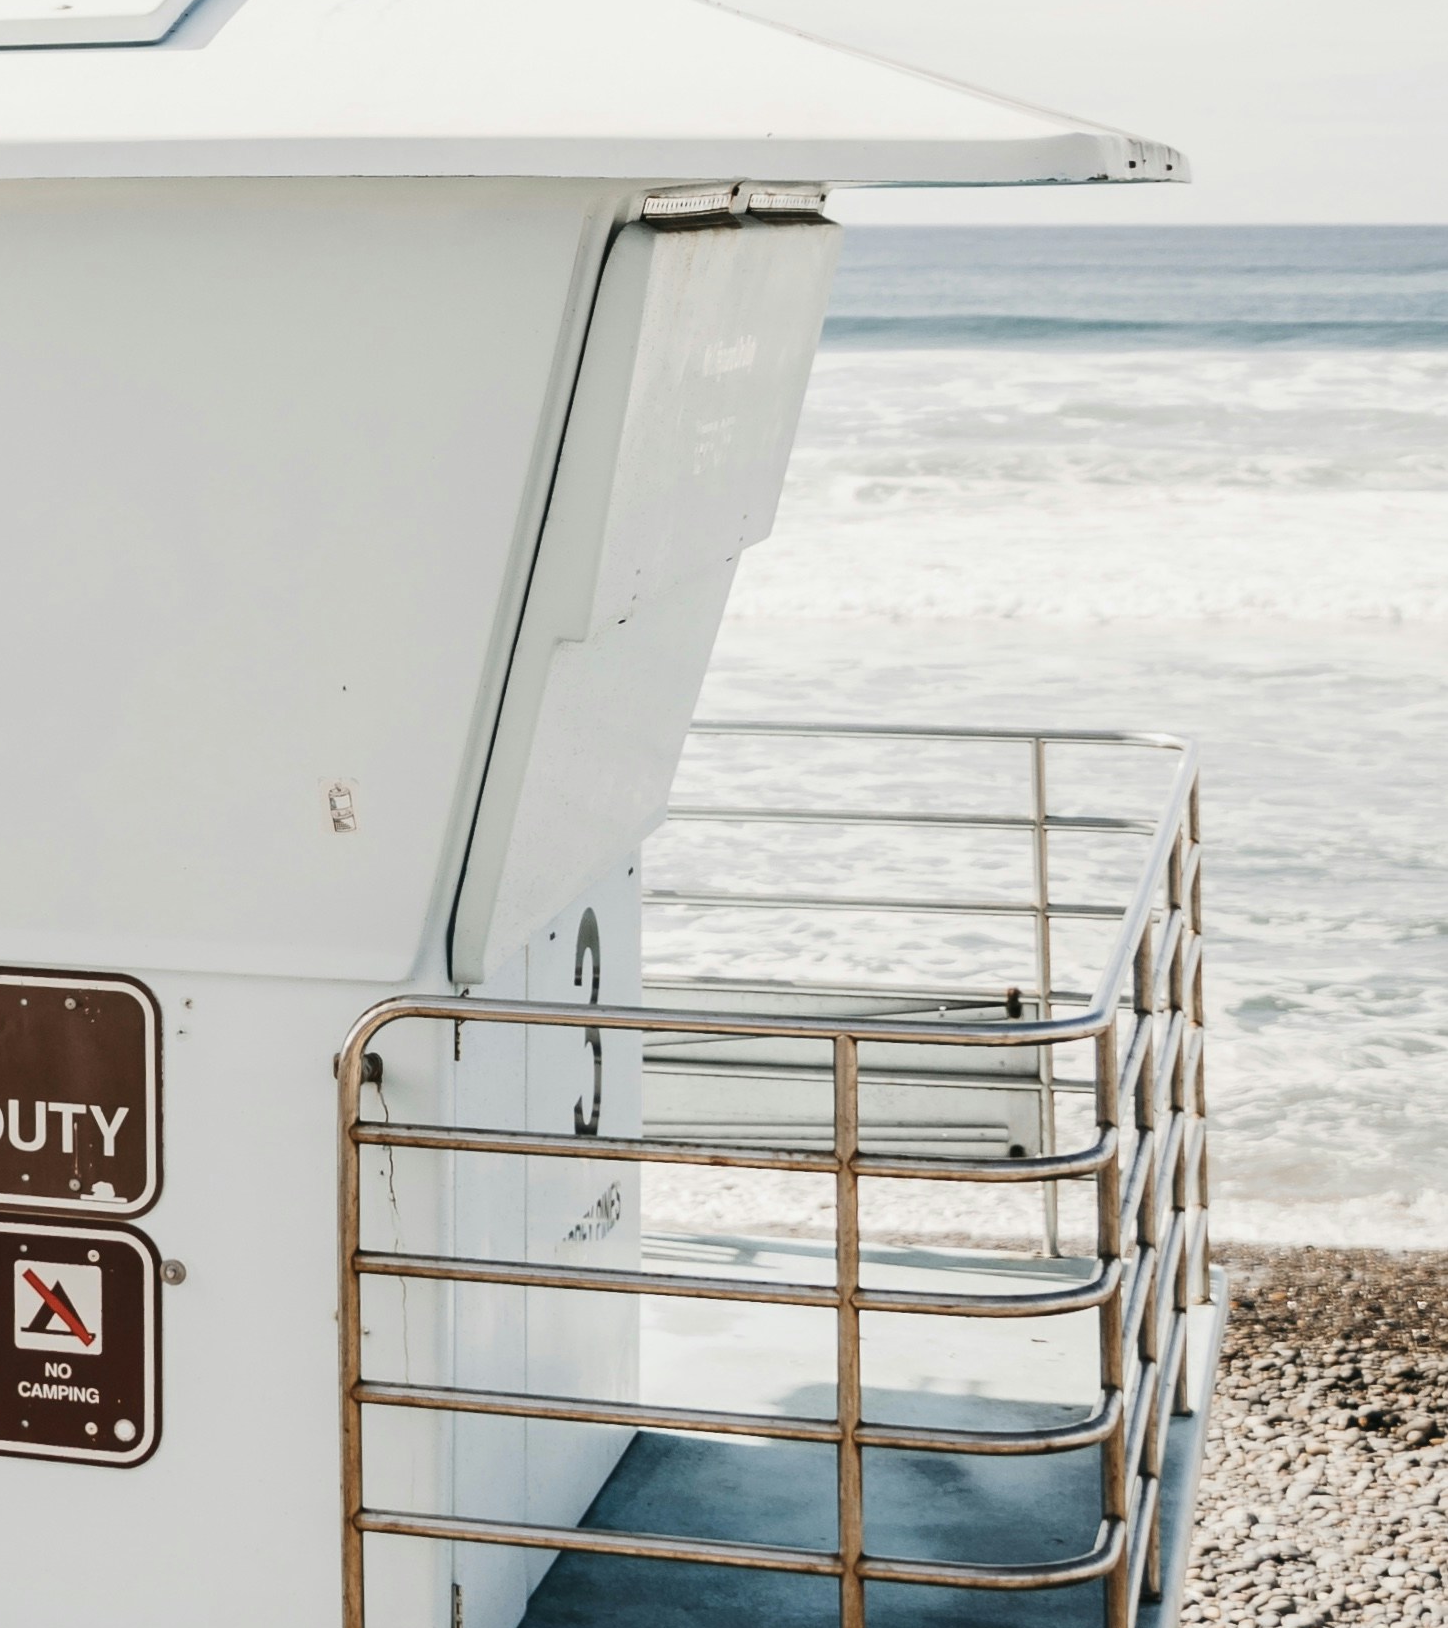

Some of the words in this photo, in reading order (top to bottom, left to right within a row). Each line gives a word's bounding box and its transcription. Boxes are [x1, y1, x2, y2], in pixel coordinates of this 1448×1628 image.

[573, 907, 603, 1135] 3
[45, 1362, 71, 1378] NO
[18, 1382, 99, 1403] CAMPING
